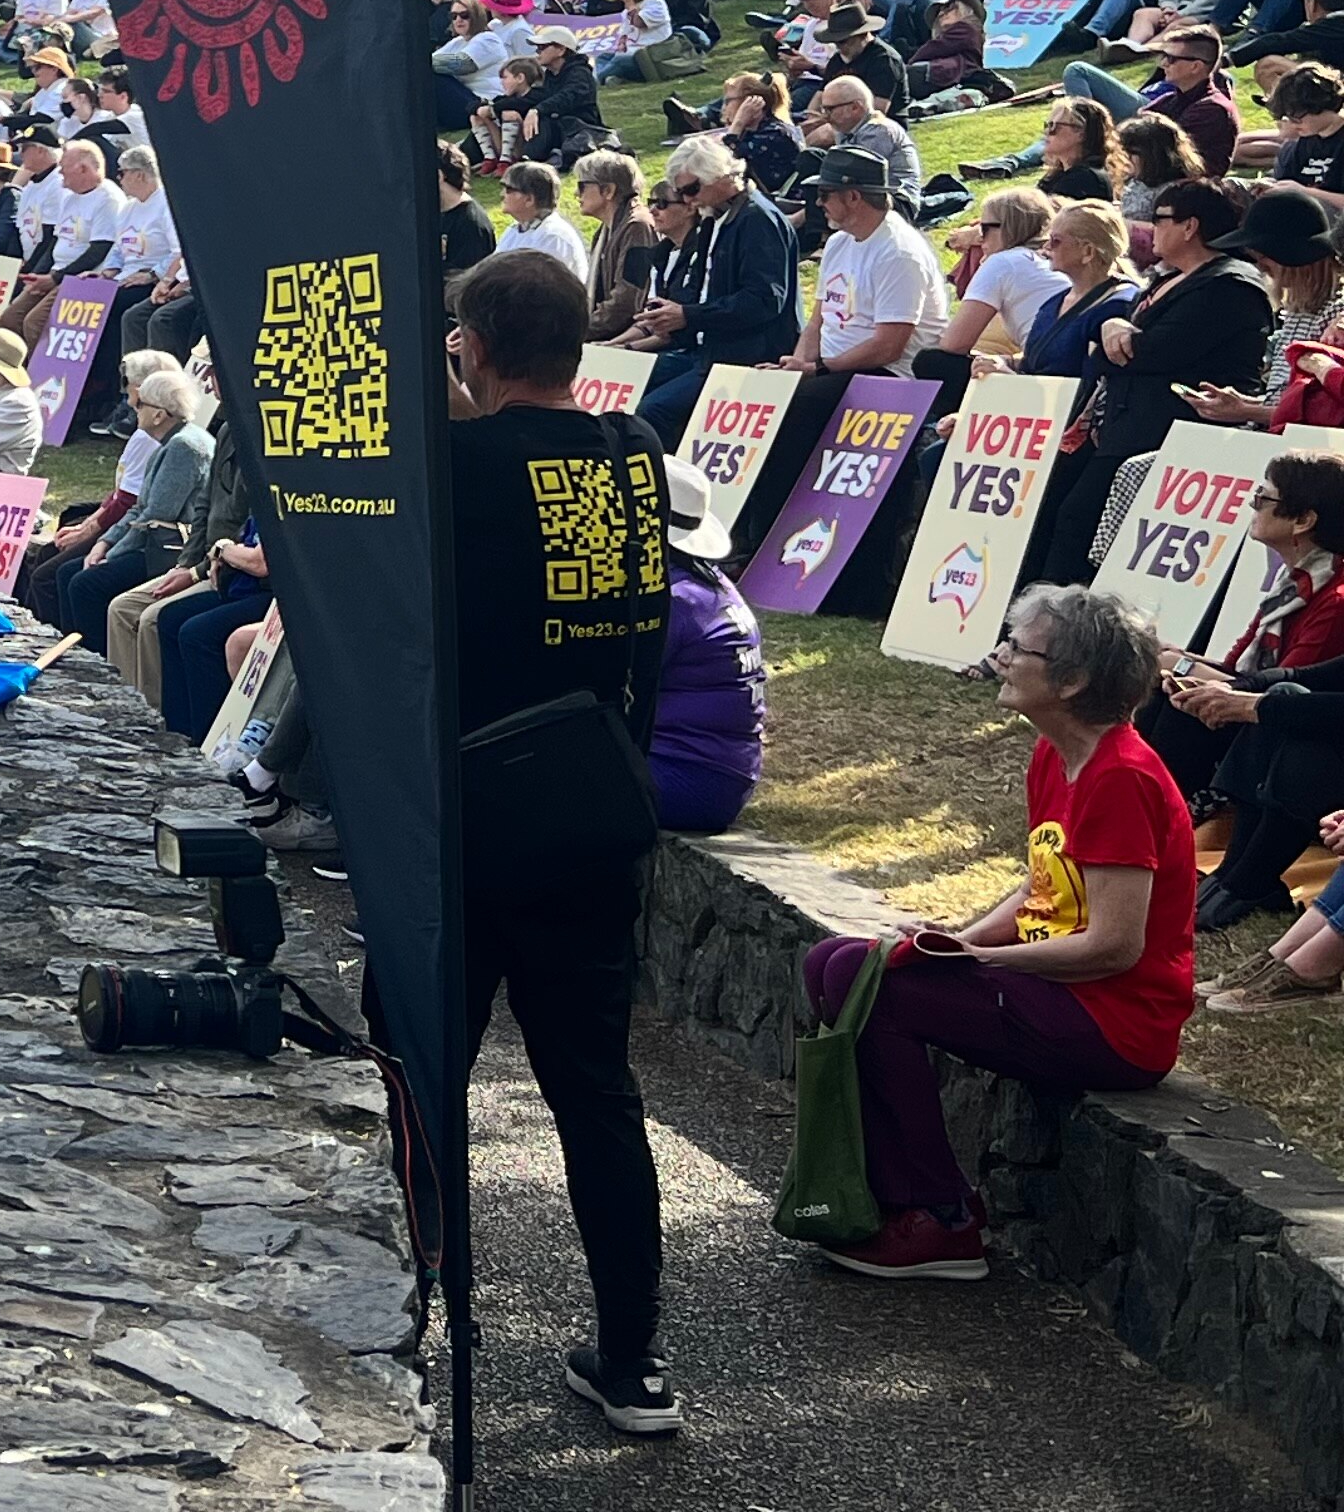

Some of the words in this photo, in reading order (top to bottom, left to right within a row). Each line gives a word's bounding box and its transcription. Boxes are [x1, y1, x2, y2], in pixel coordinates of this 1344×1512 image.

[577, 23, 621, 39] VOT
[992, 11, 1062, 25] YES!
[56, 299, 105, 328] VOTE
[45, 327, 92, 362] YES!
[703, 399, 776, 439] VOTE
[835, 409, 913, 450] VOTE
[966, 413, 1052, 460] VOTE
[691, 439, 757, 485] YES!
[814, 449, 891, 497] YES!
[284, 491, 396, 515] Yes23.com.au
[949, 462, 1037, 518] YES!
[1153, 465, 1254, 525] VOTE
[1126, 518, 1228, 587] YES!
[942, 567, 978, 589] yes23
[567, 617, 661, 638] Yes23.cm.au
[793, 1203, 830, 1217] coles
